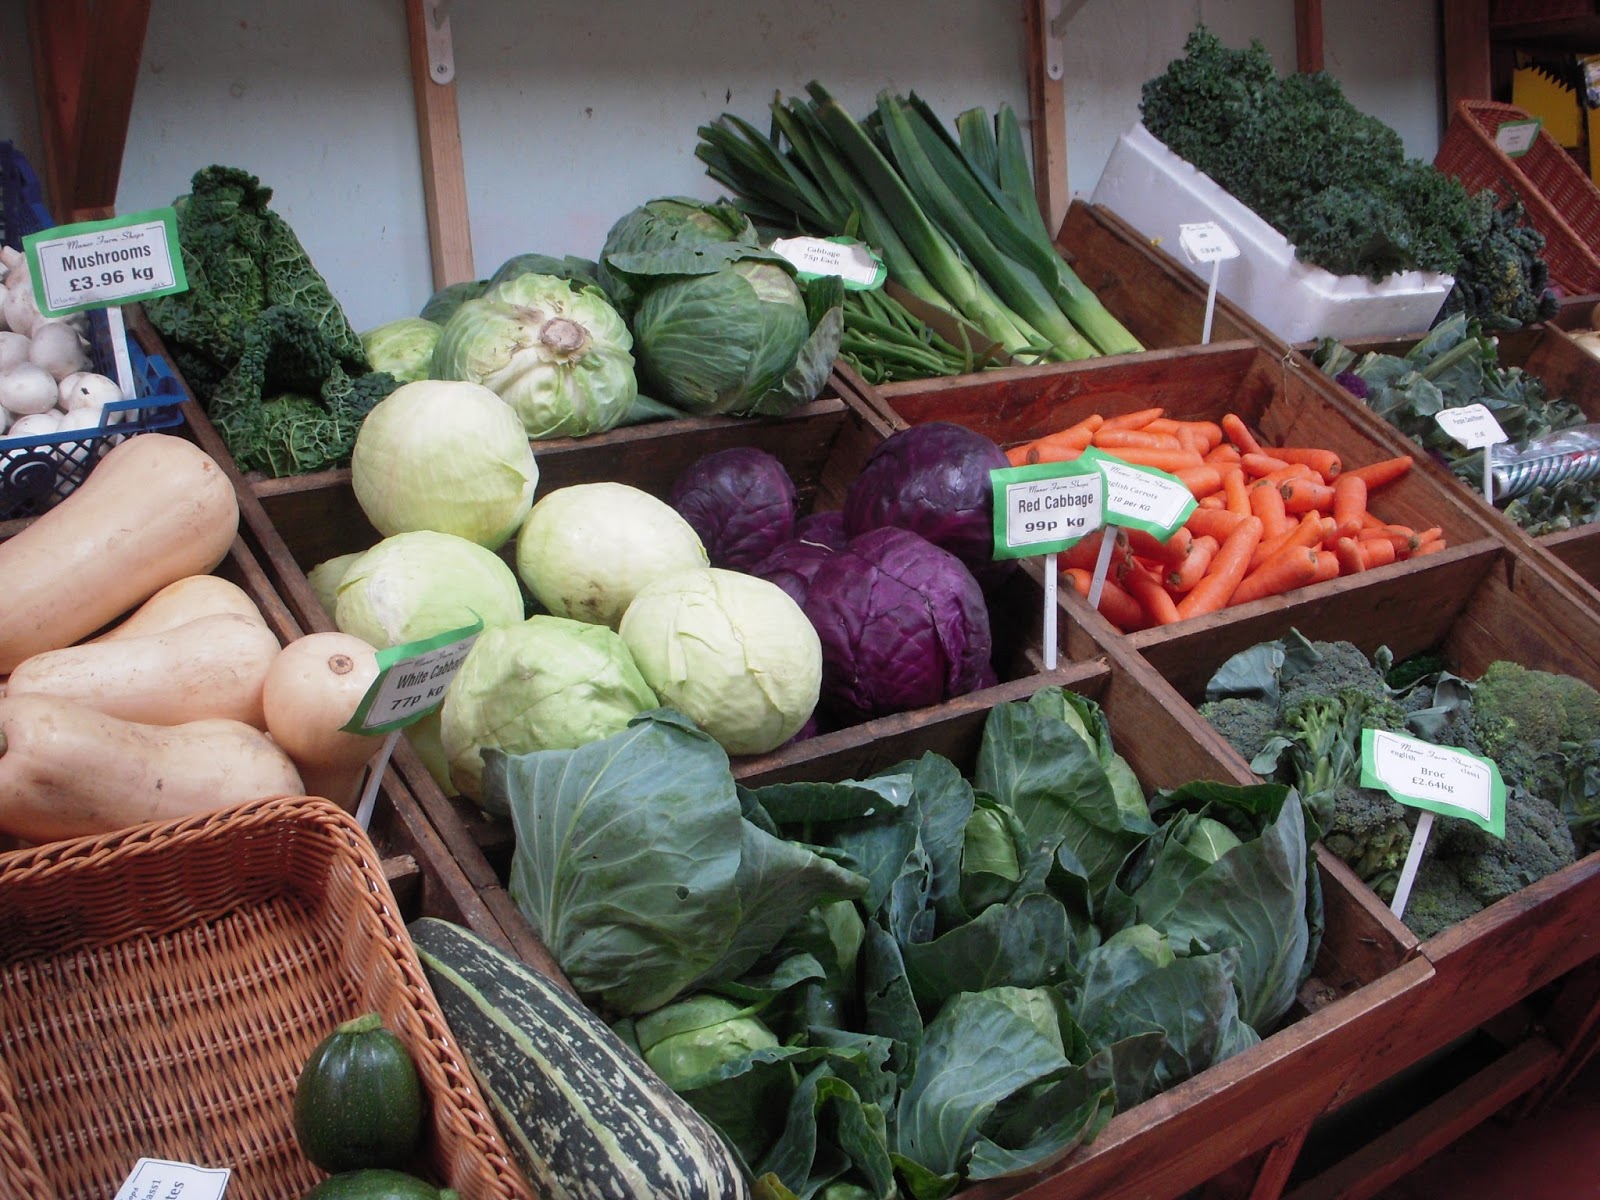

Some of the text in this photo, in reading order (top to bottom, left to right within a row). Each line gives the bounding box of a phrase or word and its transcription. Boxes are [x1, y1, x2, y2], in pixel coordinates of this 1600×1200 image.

[120, 231, 145, 241] Shops
[61, 244, 152, 272] Mushrooms
[807, 246, 841, 258] Cabbage
[820, 256, 840, 266] Each
[69, 266, 155, 292] £3.96 kg
[1107, 480, 1159, 500] nglish Carrots
[1018, 492, 1095, 514] Red Cabbage
[1123, 500, 1138, 508] per
[1139, 503, 1152, 512] KG
[1024, 517, 1086, 533] 99p kg
[396, 670, 429, 690] White
[391, 694, 423, 711] 77p
[1390, 749, 1417, 762] english
[1400, 742, 1424, 756] Manor
[1420, 767, 1446, 779] Broc
[1411, 776, 1455, 794] £2.64kg
